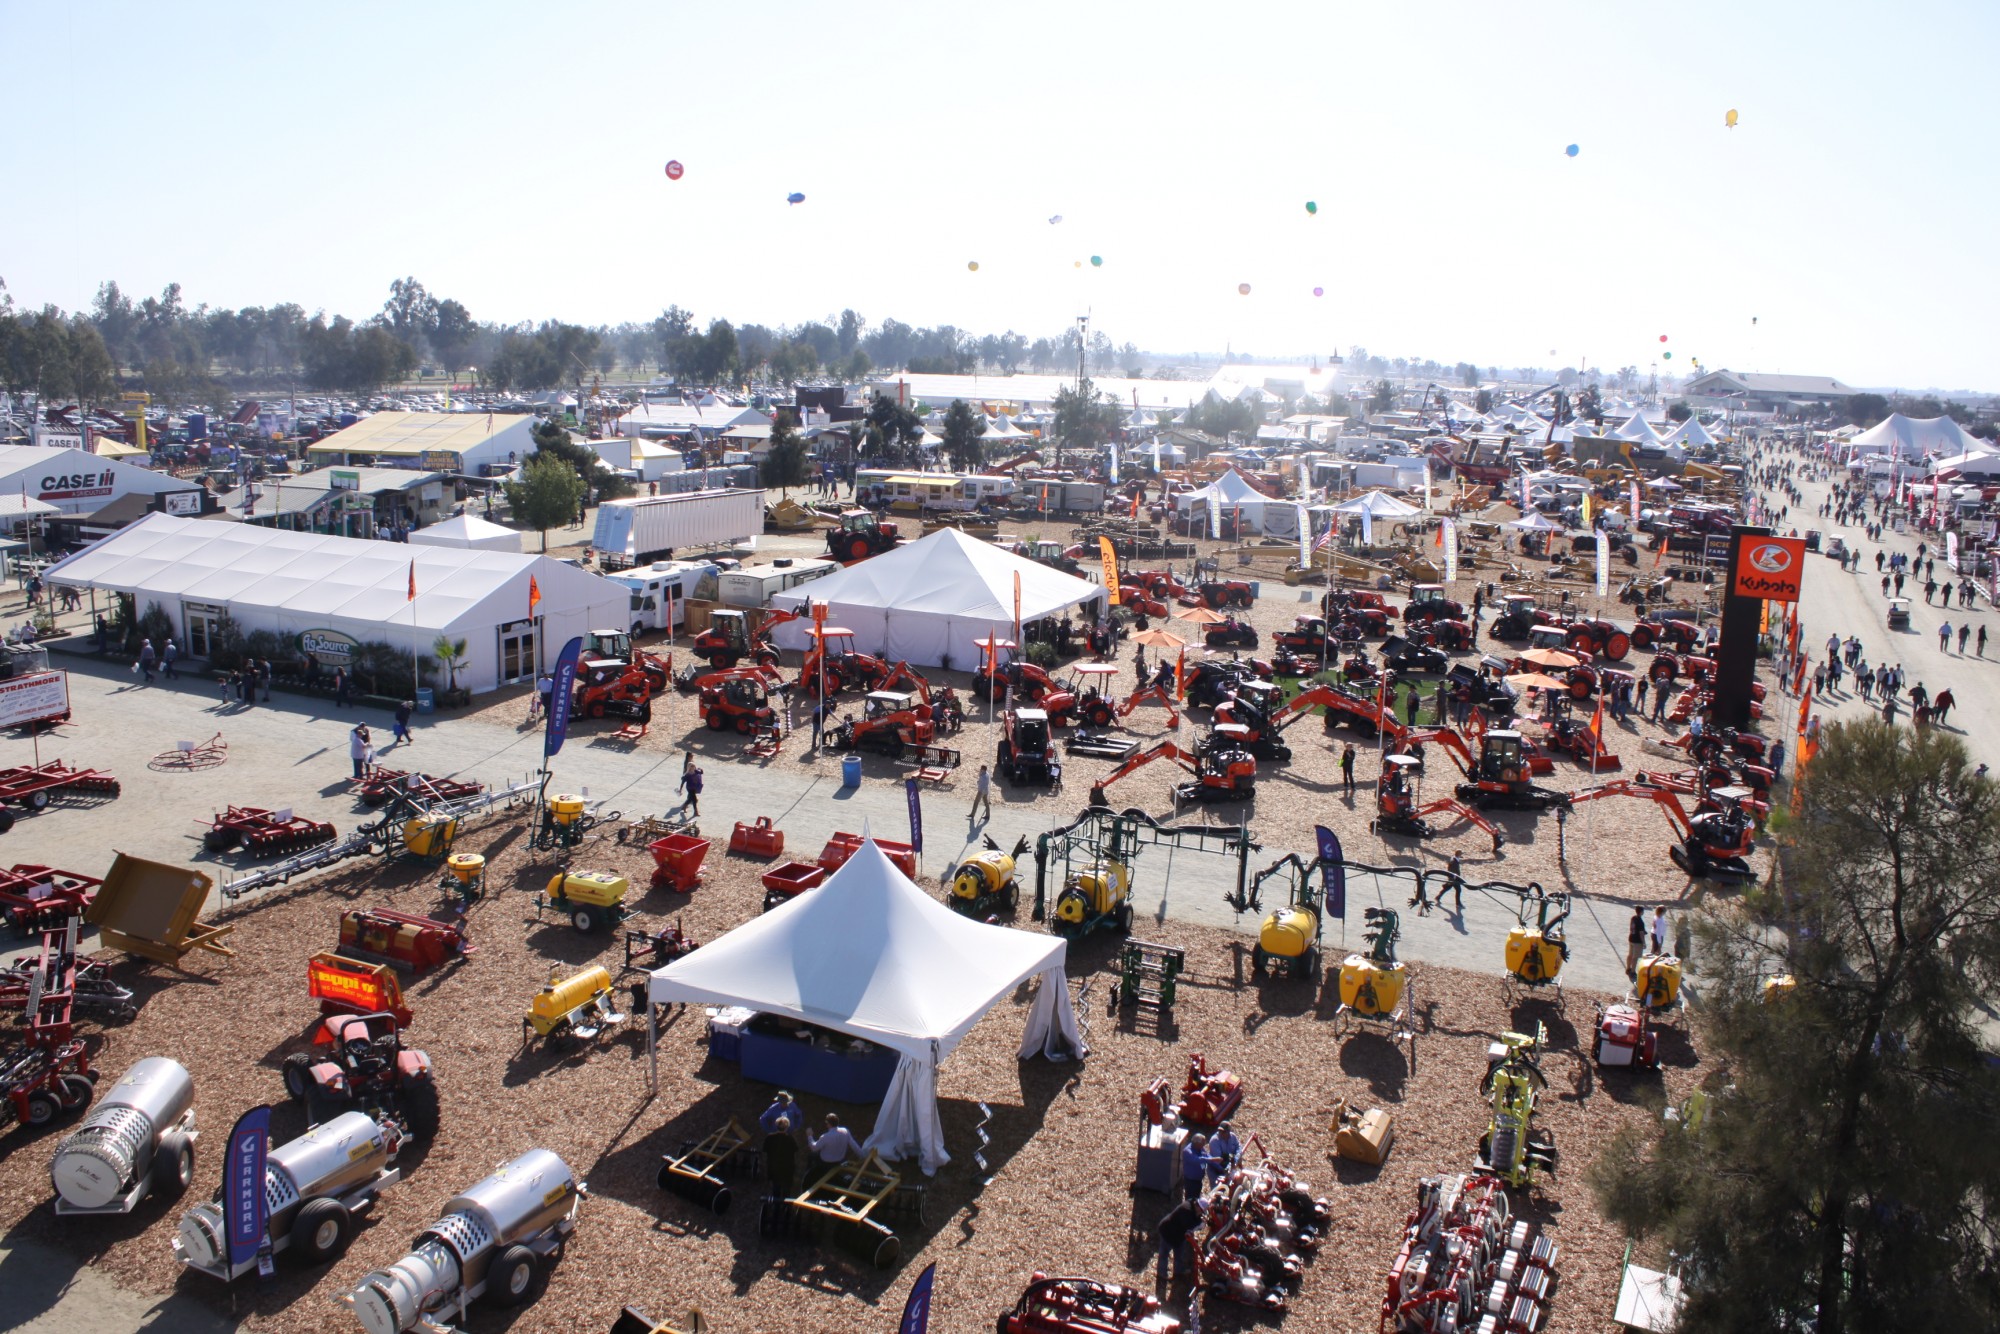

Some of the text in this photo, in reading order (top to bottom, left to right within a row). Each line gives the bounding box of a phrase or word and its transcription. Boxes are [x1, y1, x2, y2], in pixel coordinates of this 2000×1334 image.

[48, 439, 72, 448] CASE
[41, 473, 96, 491] CASE
[71, 488, 112, 497] AGRICULTURE
[1740, 576, 1796, 594] Kubota
[303, 633, 351, 654] Ag Source
[0, 676, 60, 694] STRATHMORE
[555, 665, 571, 727] GEARMORE
[1323, 843, 1335, 901] GERMORE
[240, 1136, 255, 1234] GEARMORE
